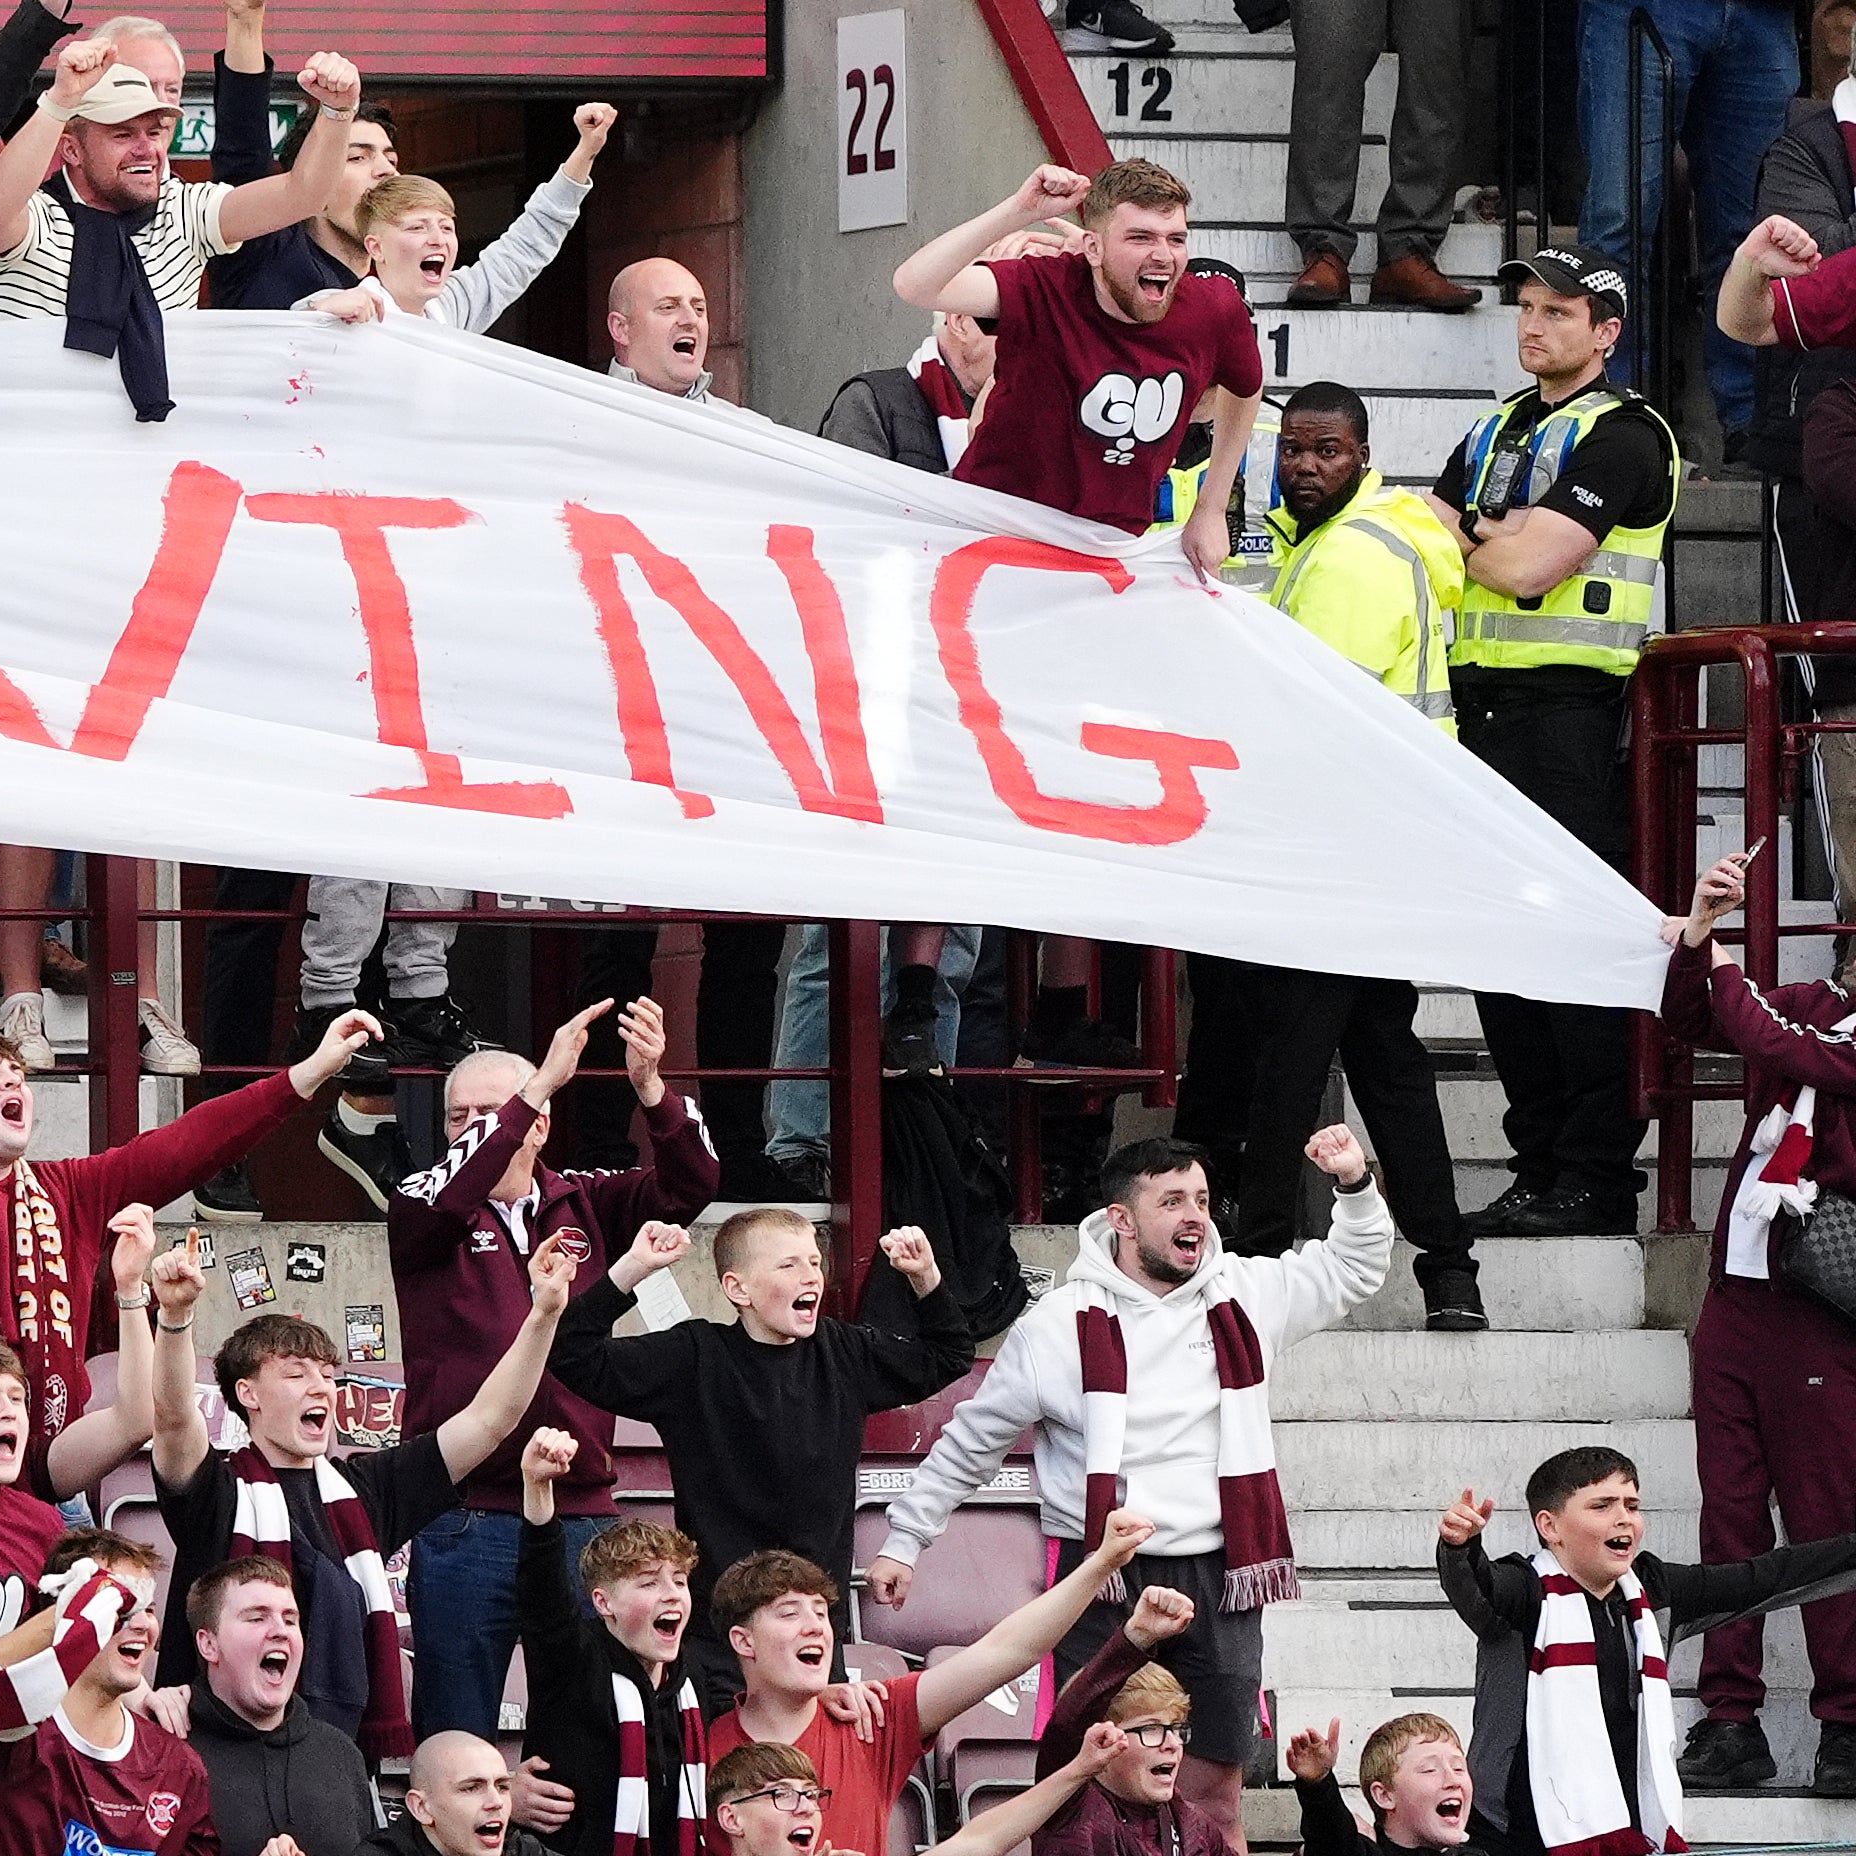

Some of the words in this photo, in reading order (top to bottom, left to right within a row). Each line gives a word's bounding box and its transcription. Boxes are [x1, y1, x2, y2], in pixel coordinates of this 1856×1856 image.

[1107, 62, 1172, 121] 12
[846, 64, 896, 176] 22
[1535, 248, 1583, 271] POLICE
[1081, 371, 1184, 443] GU
[1103, 449, 1135, 465] 22
[1238, 537, 1271, 553] POLIC
